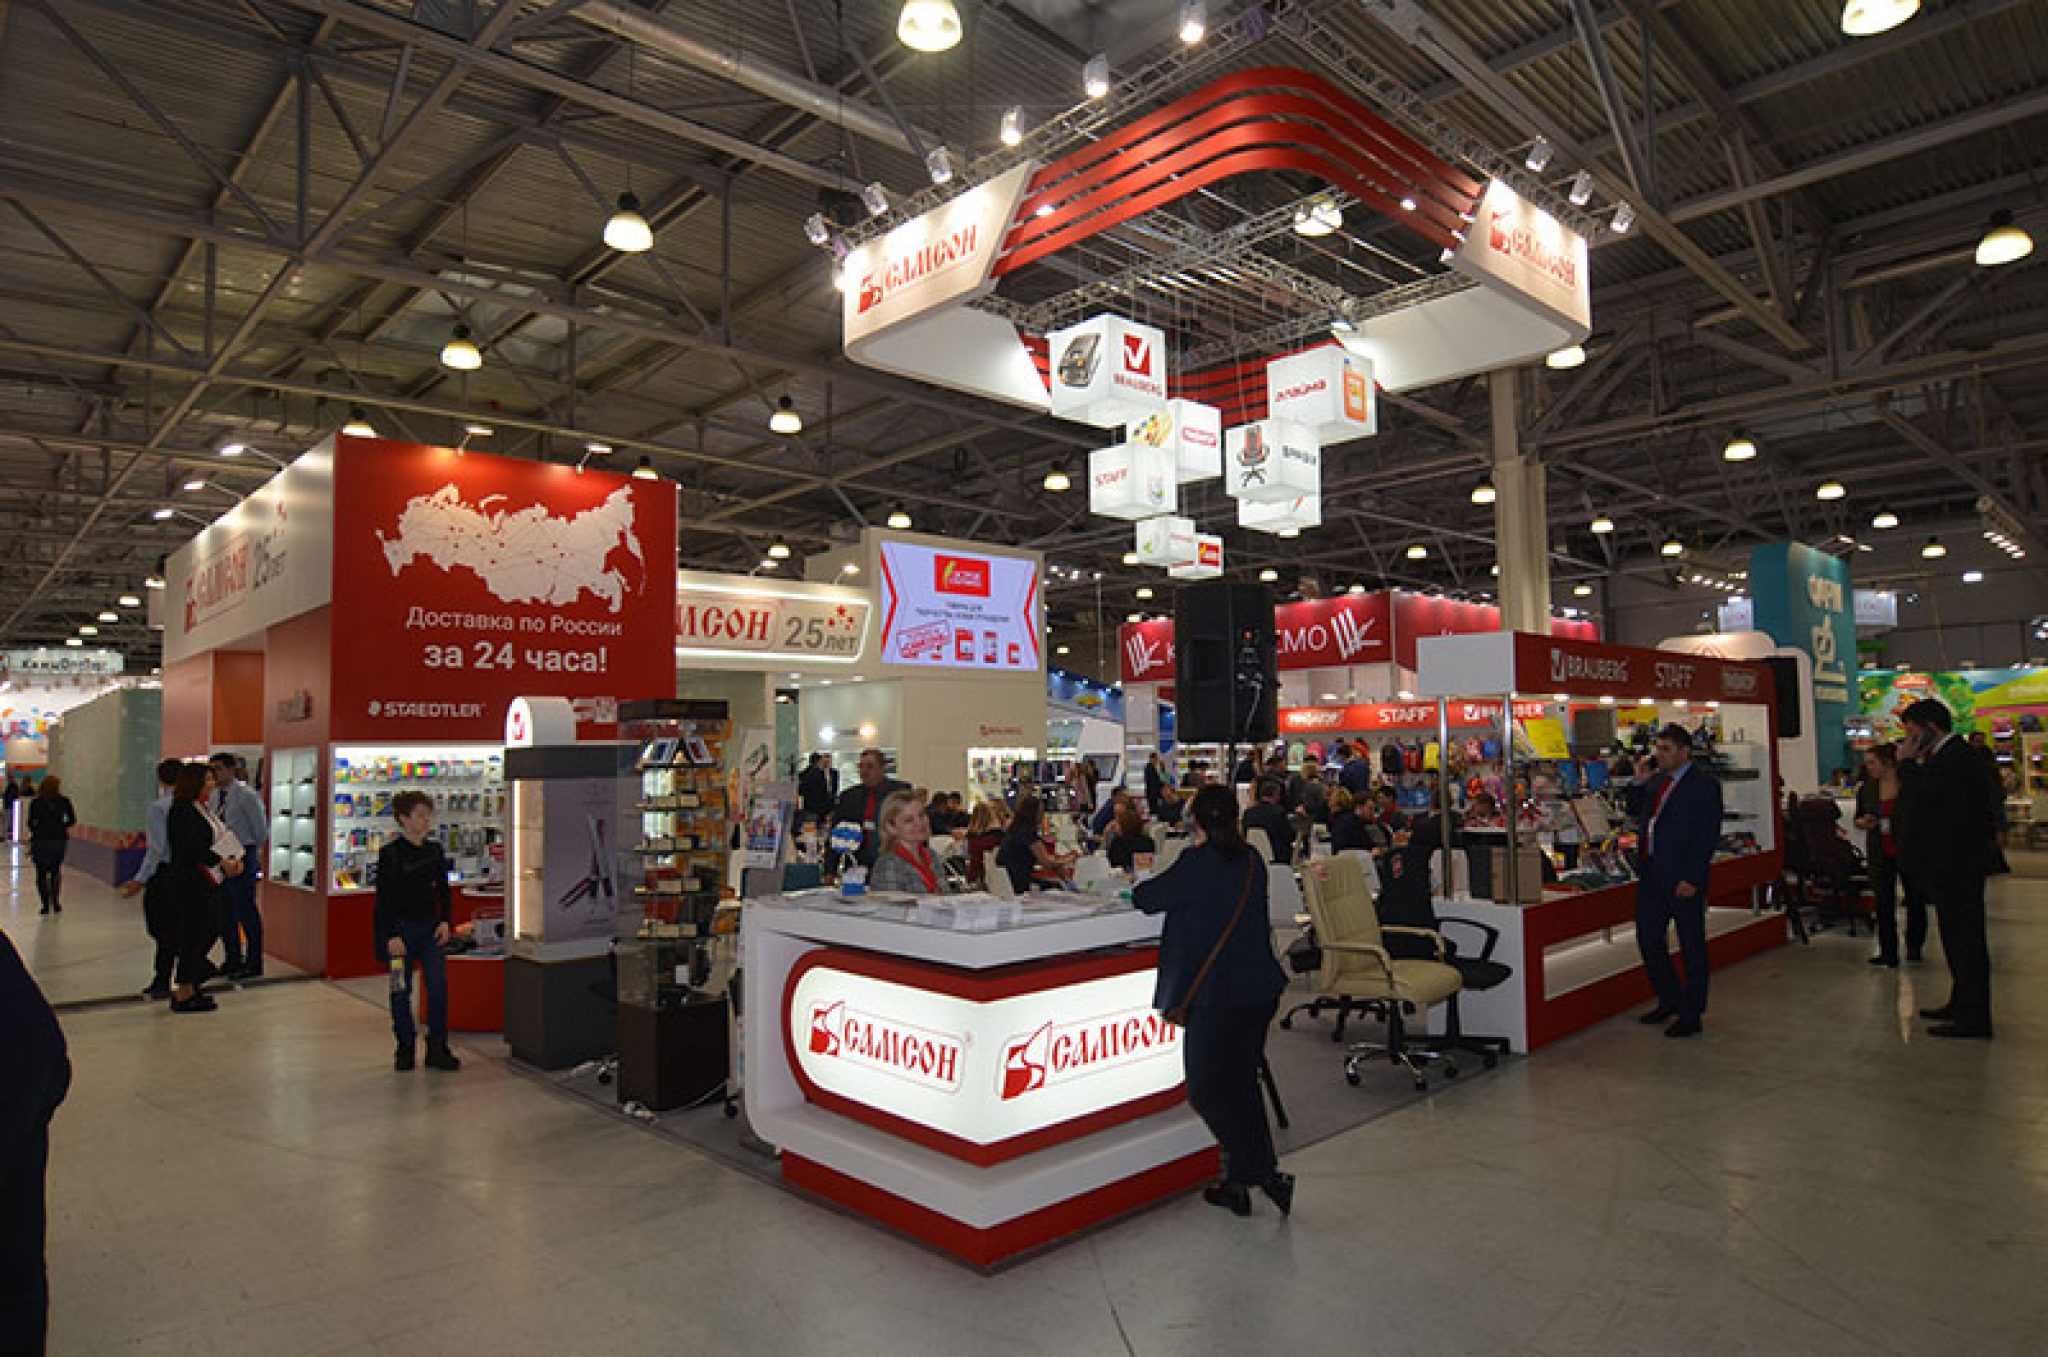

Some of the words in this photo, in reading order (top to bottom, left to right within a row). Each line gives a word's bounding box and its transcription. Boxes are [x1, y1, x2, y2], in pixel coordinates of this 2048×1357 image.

[405, 606, 514, 631] Доставка
[519, 616, 546, 633] по
[551, 615, 623, 636] России
[784, 616, 825, 649] 25
[824, 635, 857, 652] лет
[424, 644, 464, 669] за
[473, 640, 515, 670] 24
[525, 646, 607, 672] часа!
[1654, 662, 1696, 689] STAFF
[383, 701, 483, 718] STAEDTLER
[1377, 706, 1431, 724] STAFF
[844, 1018, 958, 1082] САМСОН
[1052, 1013, 1176, 1073] САМСОН
